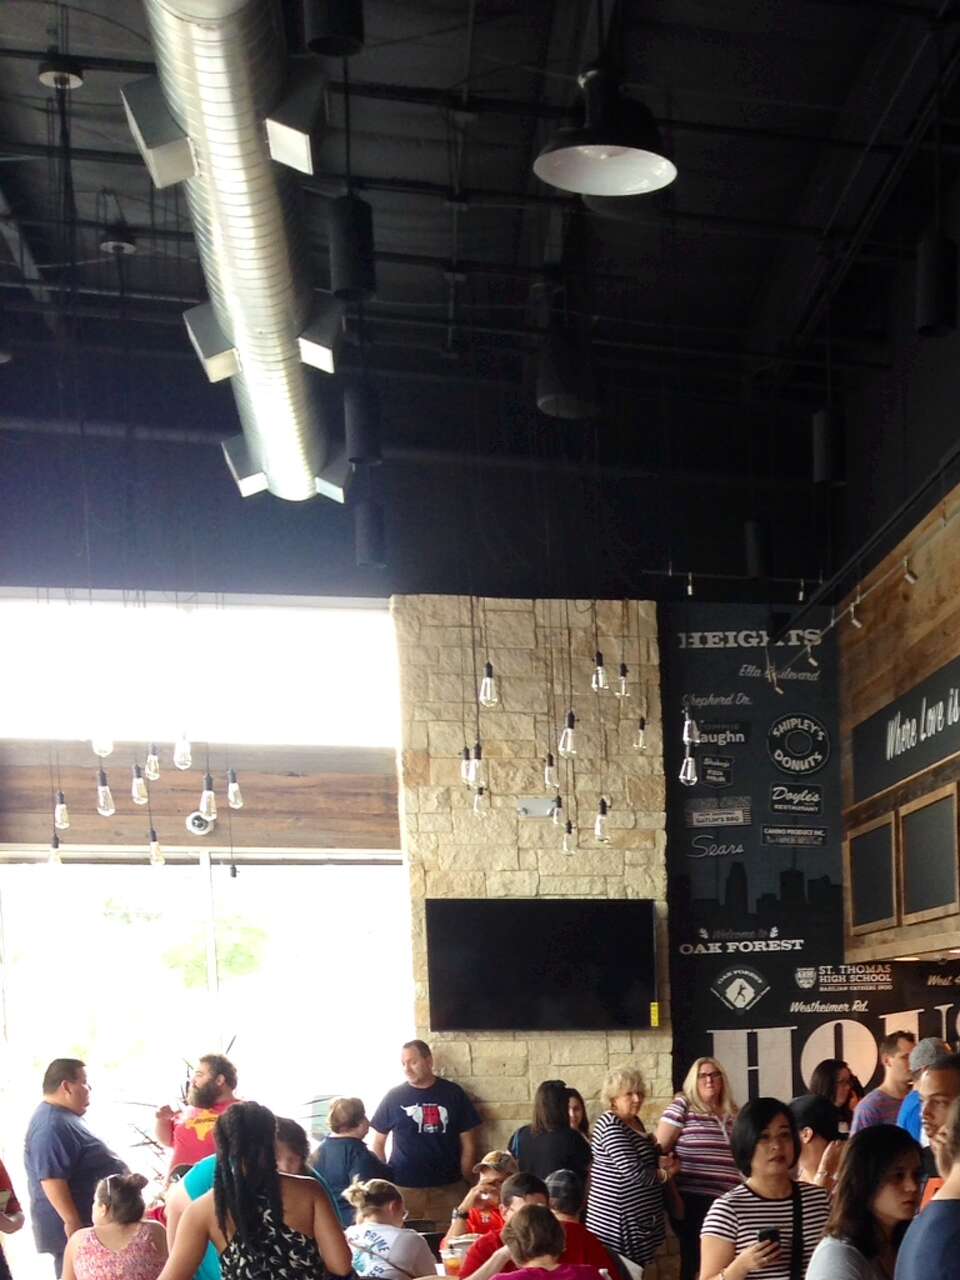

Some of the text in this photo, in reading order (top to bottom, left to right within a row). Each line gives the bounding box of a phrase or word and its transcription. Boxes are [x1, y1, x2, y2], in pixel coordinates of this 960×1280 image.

[772, 717, 825, 741] SHIPLEY'S
[886, 710, 918, 761] Where
[920, 696, 945, 742] Love
[947, 687, 960, 726] is
[698, 731, 745, 746] aughn
[773, 749, 824, 771] DONUTS
[686, 834, 745, 858] Sears
[679, 939, 805, 955] OAK FOREST
[818, 965, 836, 976] ST.
[839, 964, 892, 974] THOMAS
[819, 973, 893, 984] HIGH SCHOOL
[789, 1000, 851, 1013] Westheimer
